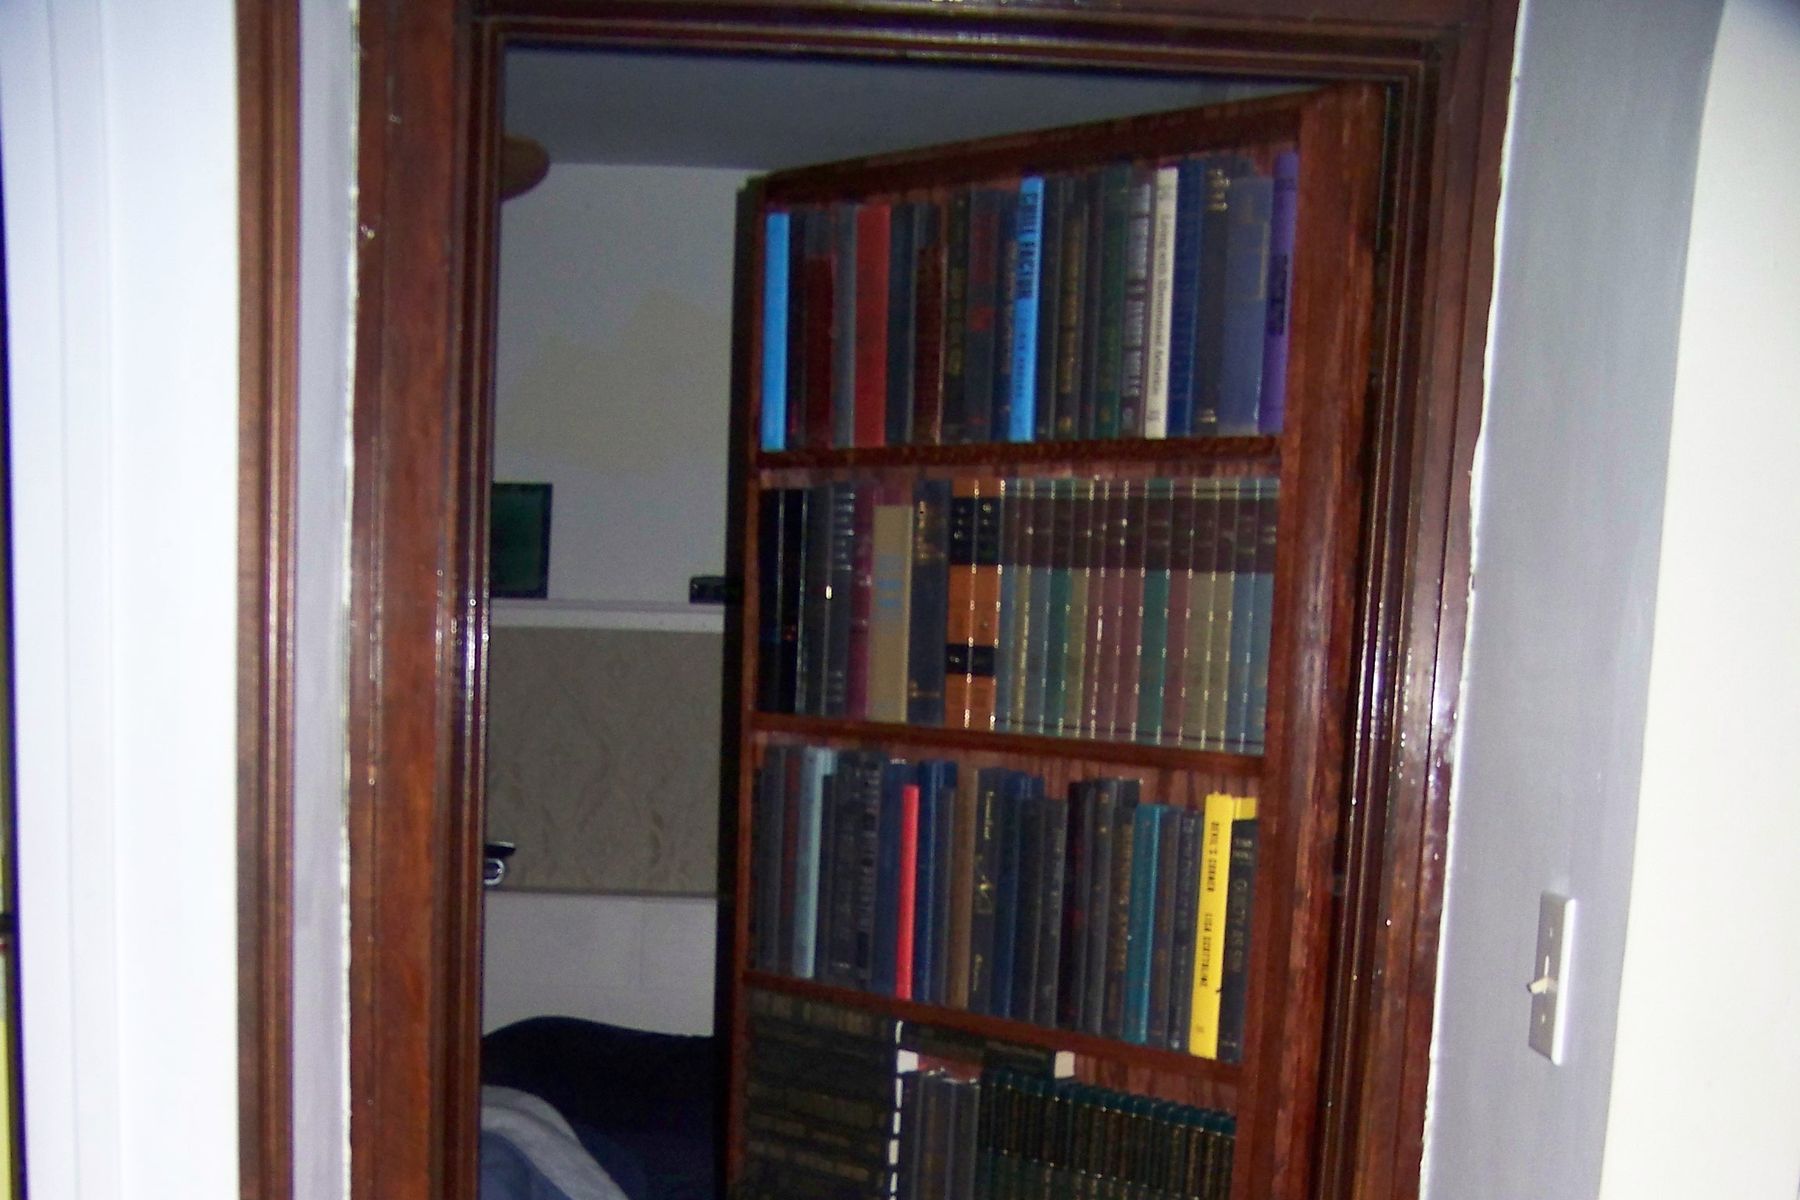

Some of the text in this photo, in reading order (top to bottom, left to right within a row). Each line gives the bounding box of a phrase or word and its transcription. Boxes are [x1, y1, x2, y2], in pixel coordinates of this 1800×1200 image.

[1207, 820, 1221, 855] DEVIL'S
[1205, 857, 1218, 893] CORNER
[1202, 913, 1214, 933] LISA
